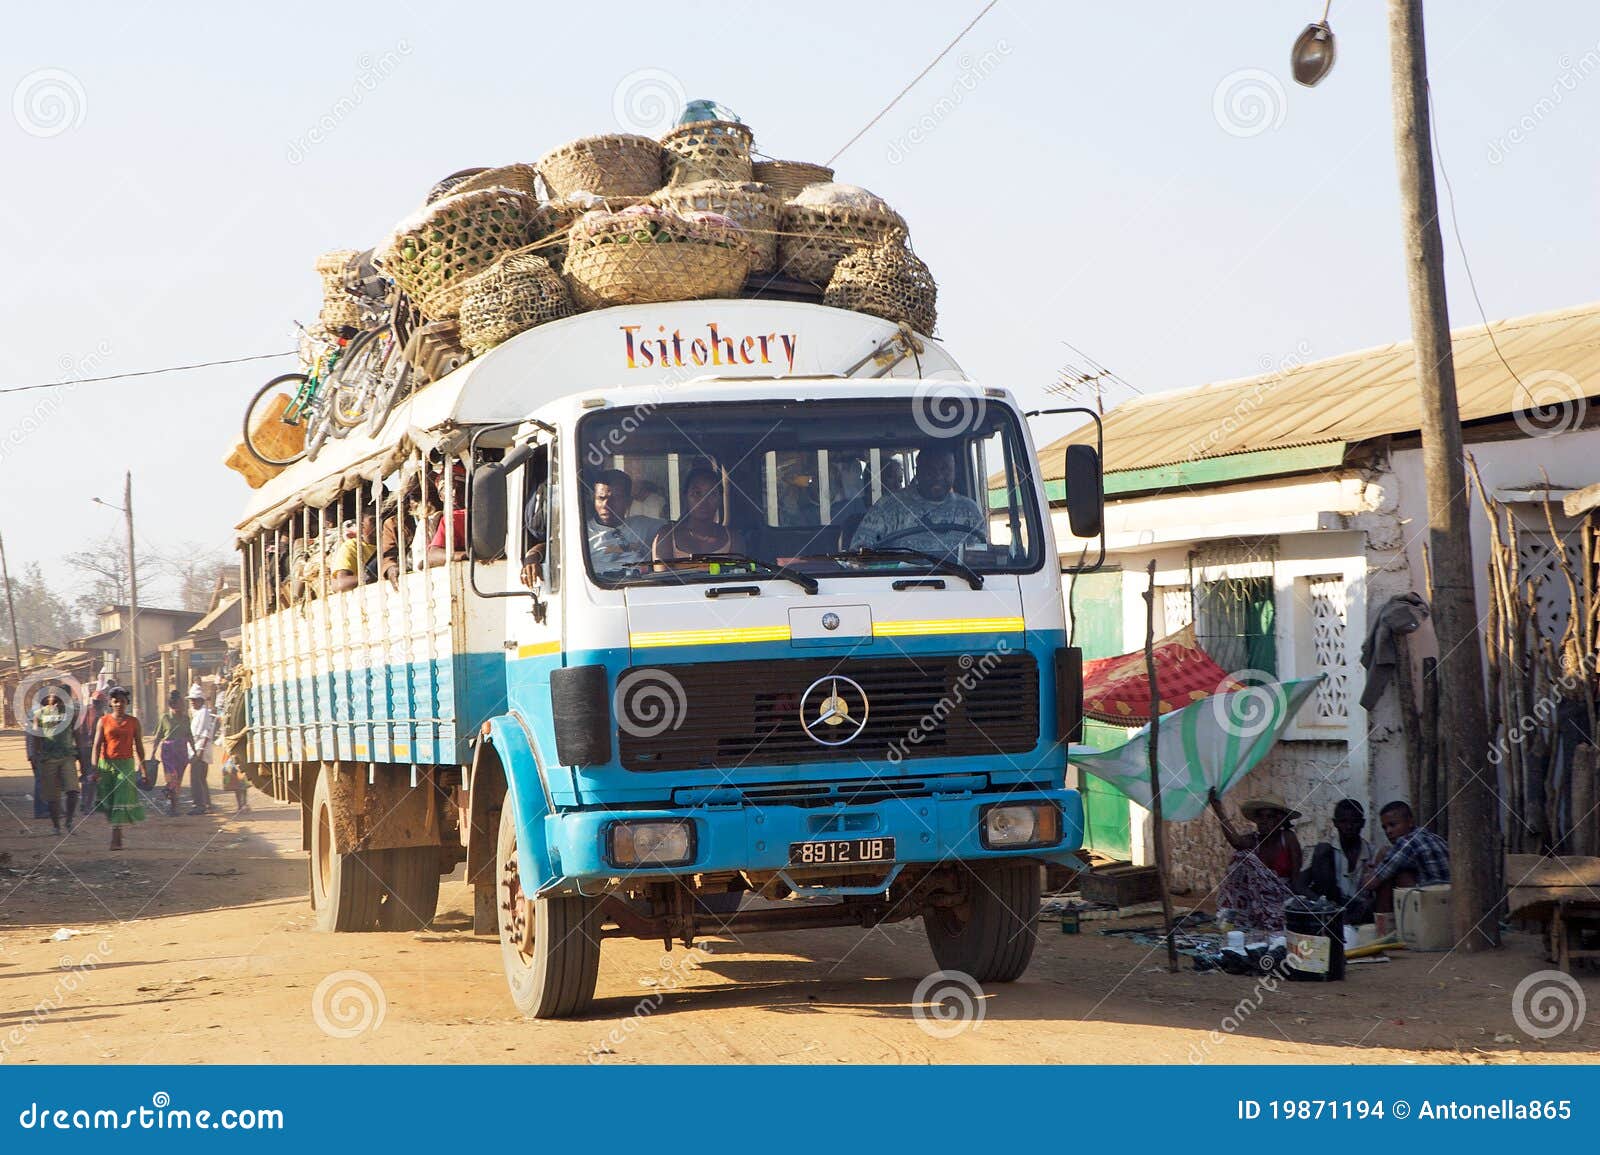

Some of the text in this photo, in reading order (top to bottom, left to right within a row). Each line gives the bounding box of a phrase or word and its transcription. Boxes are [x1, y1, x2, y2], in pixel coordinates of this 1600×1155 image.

[619, 322, 797, 374] Tsitohery
[802, 840, 883, 863] 8912 UB
